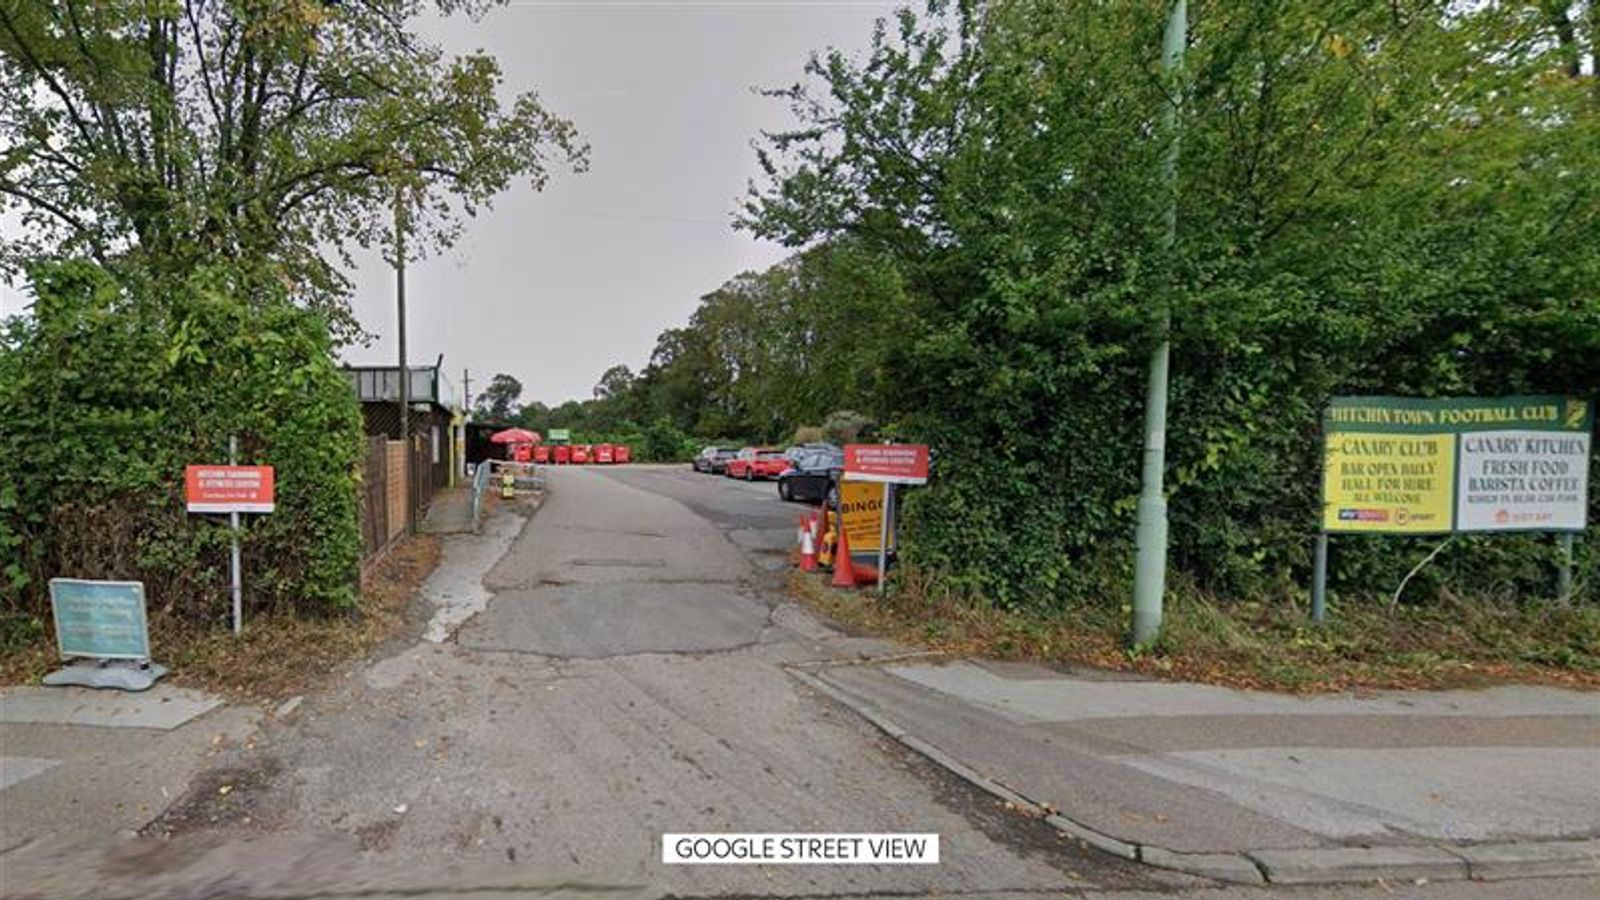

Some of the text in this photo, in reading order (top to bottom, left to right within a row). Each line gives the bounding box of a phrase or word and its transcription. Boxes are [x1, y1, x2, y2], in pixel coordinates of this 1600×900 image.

[1392, 408, 1435, 424] TOWN
[1439, 407, 1518, 424] FOOTBALL
[1522, 404, 1558, 420] CLUB
[1341, 440, 1438, 456] CANARY CLUB
[1465, 438, 1585, 454] CANARY KITCHEN
[1341, 462, 1364, 475] BAR
[1367, 462, 1399, 475] OPEN
[1482, 460, 1569, 475] FRESH FOOD
[1342, 478, 1372, 490] HALL
[1376, 478, 1400, 490] FOR
[1468, 478, 1579, 491] BARISTA COFFEE
